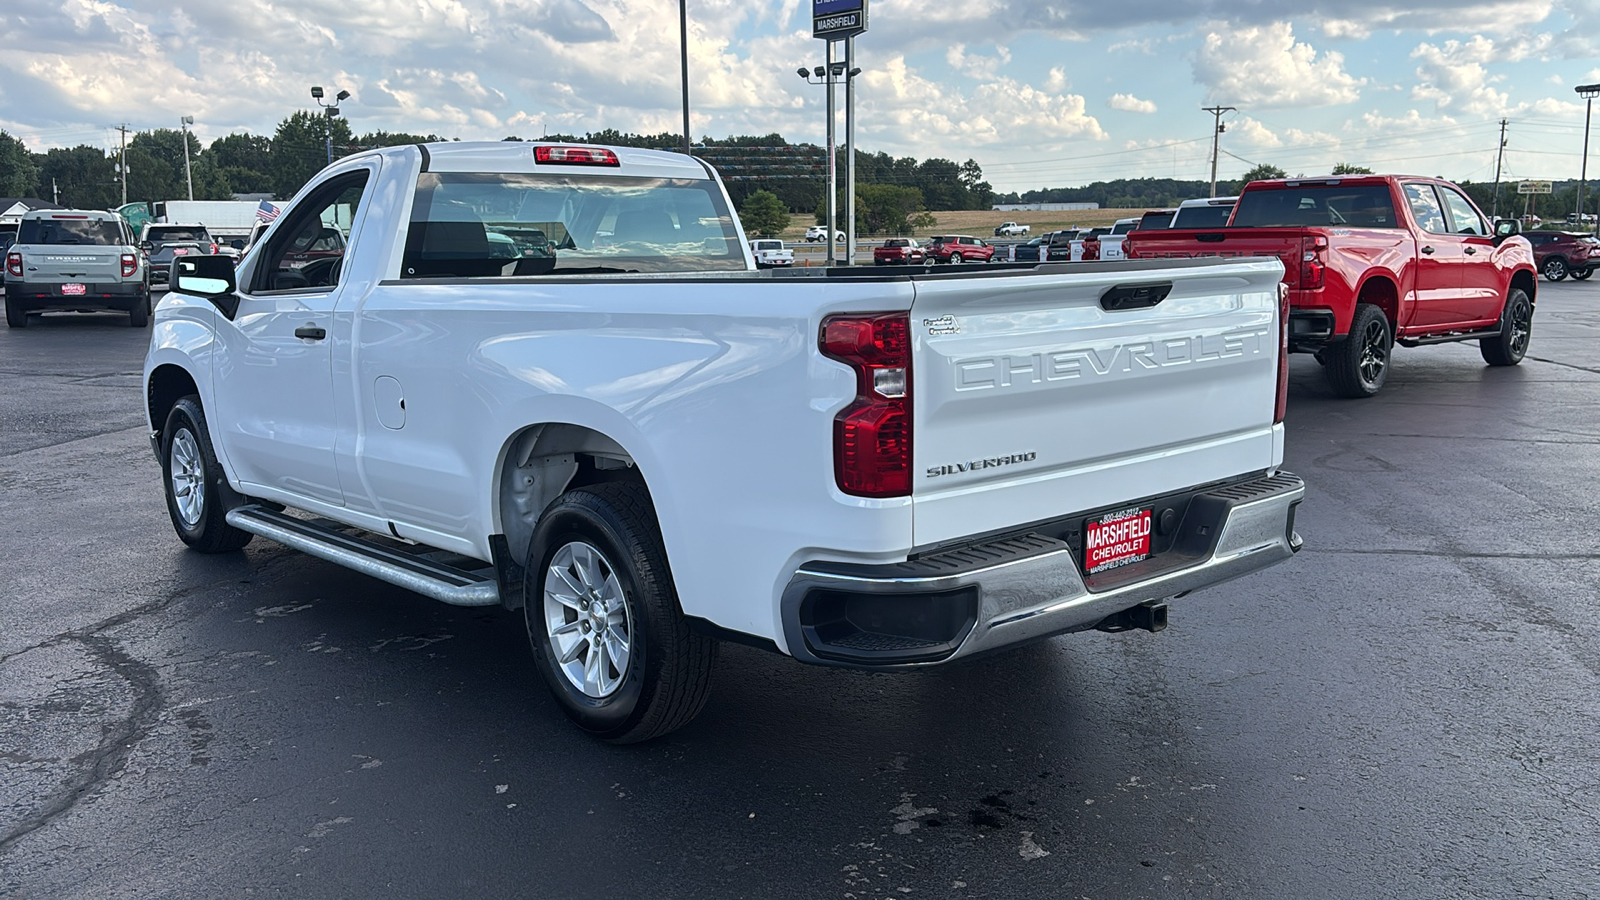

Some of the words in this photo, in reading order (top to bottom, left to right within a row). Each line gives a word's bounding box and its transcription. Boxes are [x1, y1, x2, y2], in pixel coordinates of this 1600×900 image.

[817, 15, 856, 30] MARSHFIELD
[955, 328, 1268, 392] CHEVROLET
[926, 451, 1037, 478] SILVERADO
[1086, 516, 1151, 549] MARSHFIELD
[1092, 538, 1144, 561] CHEVROLET
[1090, 560, 1119, 574] MARSHFIELD
[1119, 553, 1147, 567] CHEVROLET
